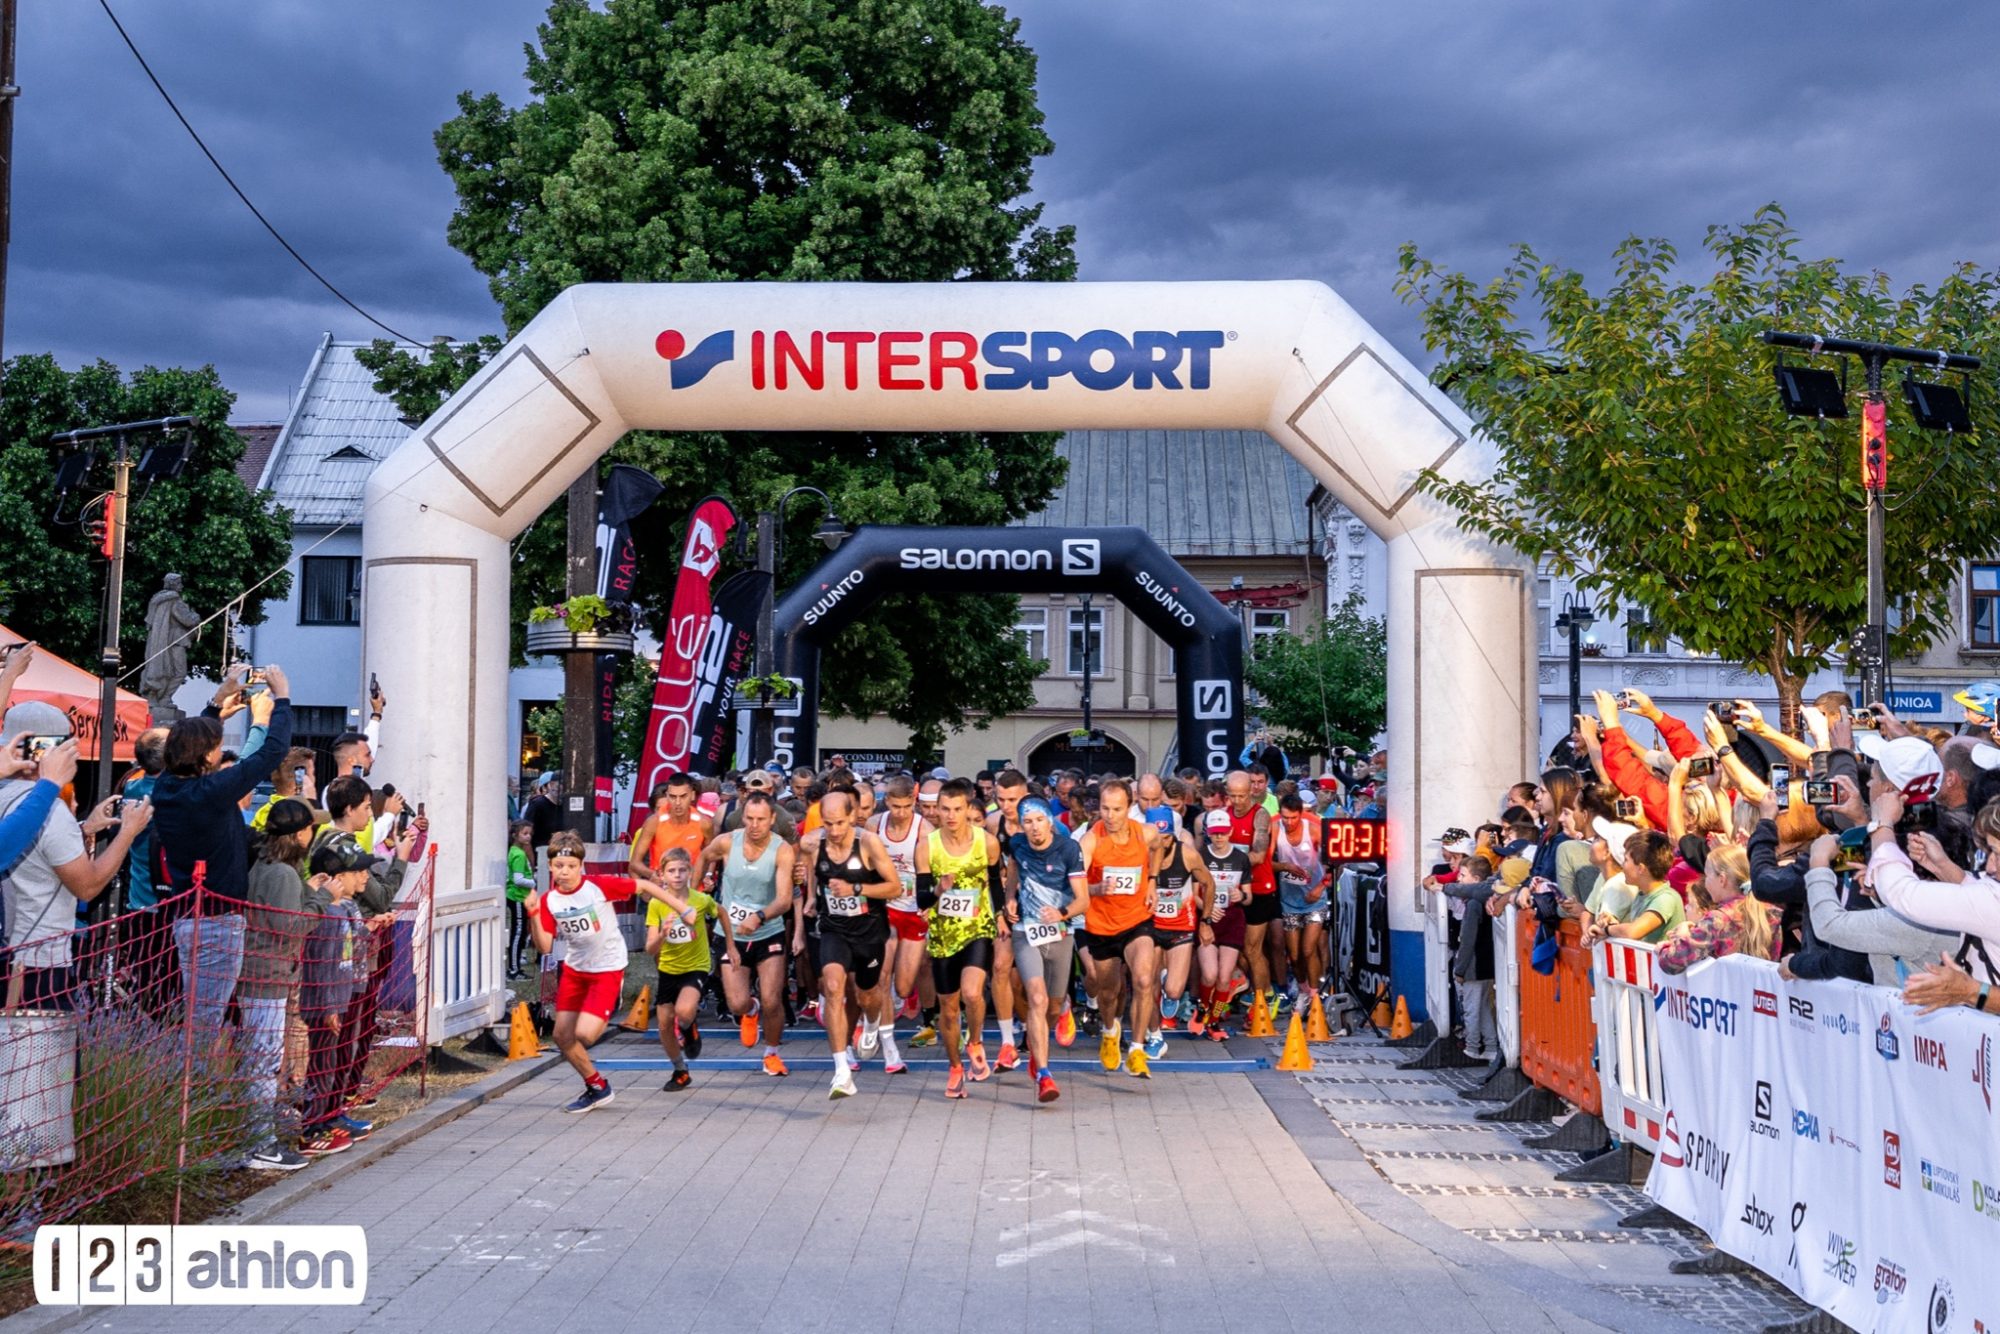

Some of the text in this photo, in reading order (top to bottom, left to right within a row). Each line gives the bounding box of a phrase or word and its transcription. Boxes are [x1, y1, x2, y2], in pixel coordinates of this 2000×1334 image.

[751, 330, 1225, 391] INTERSPORT
[803, 569, 864, 626] SUUNTO
[1135, 571, 1195, 627] SUUNTO
[708, 630, 750, 762] RIDE YOUR RACE
[1889, 697, 1934, 709] UNIQA
[875, 754, 904, 762] HAND
[830, 897, 858, 912] 363
[942, 897, 971, 913] 287
[561, 918, 590, 934] 350
[1028, 925, 1058, 941] 309
[1789, 996, 1815, 1020] R2
[1914, 1034, 1948, 1072] IMPA
[1792, 1108, 1820, 1142] HOKA
